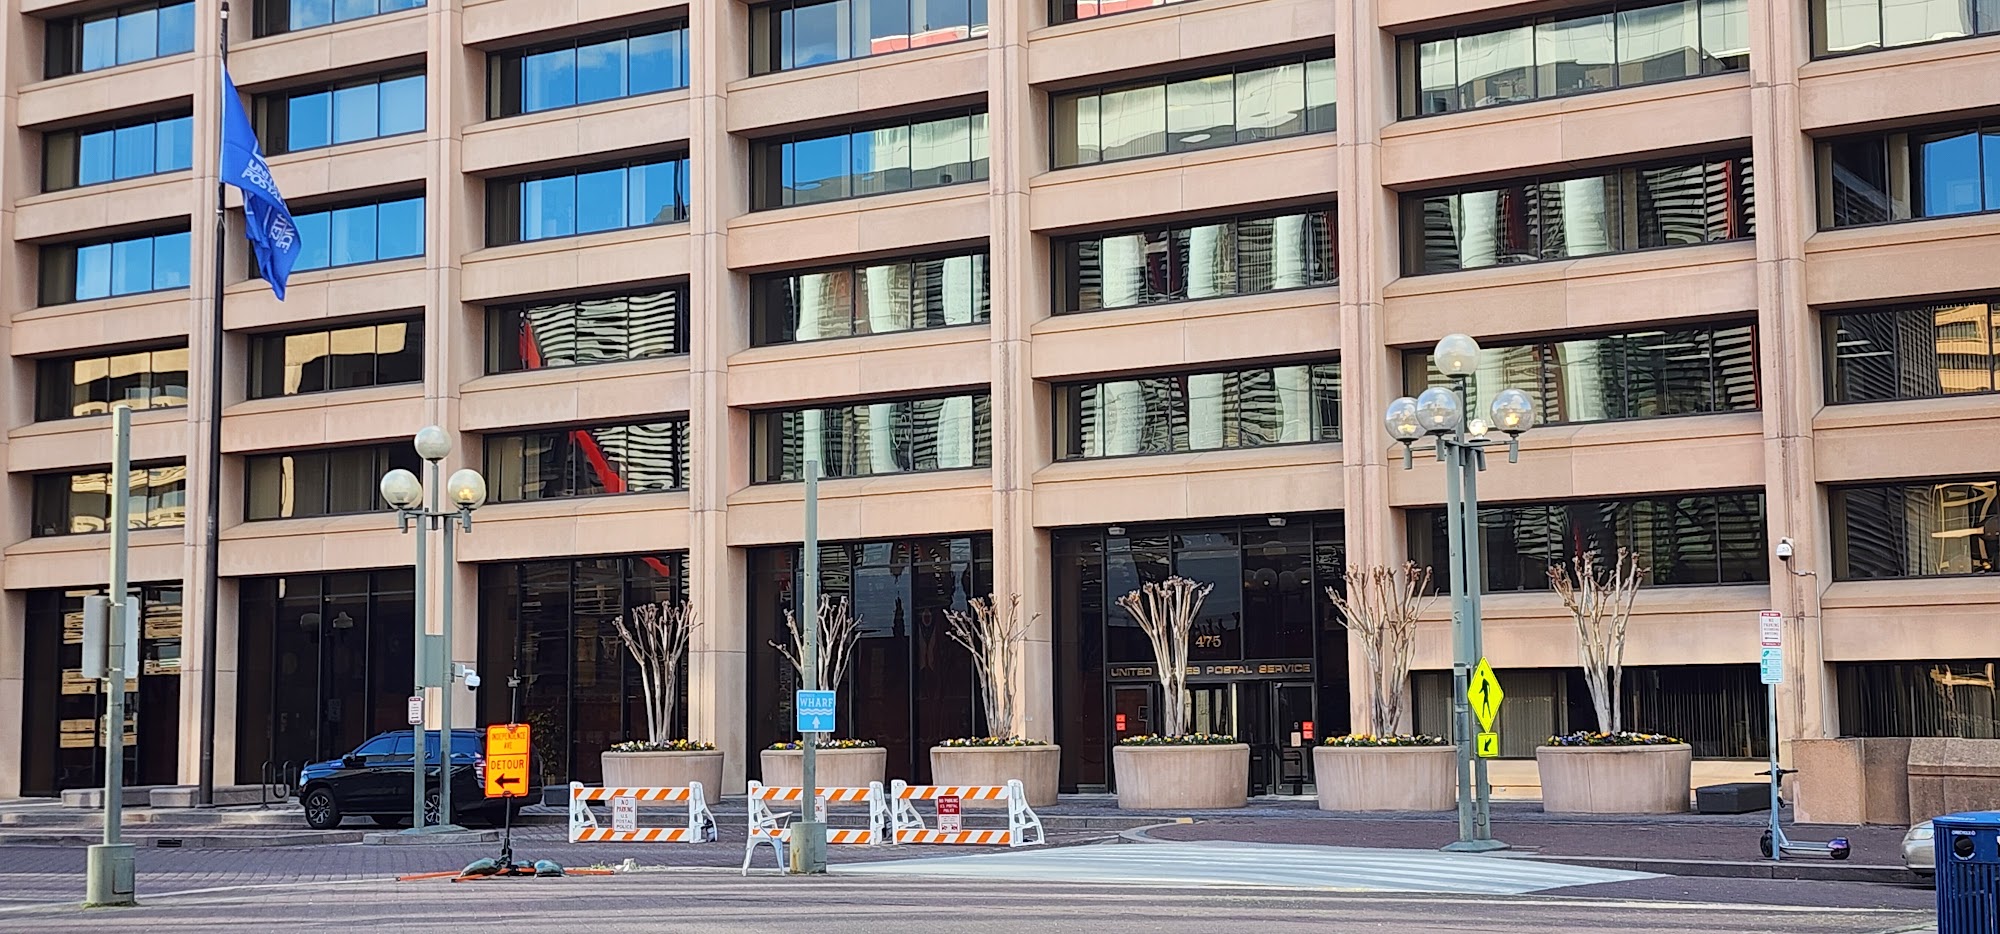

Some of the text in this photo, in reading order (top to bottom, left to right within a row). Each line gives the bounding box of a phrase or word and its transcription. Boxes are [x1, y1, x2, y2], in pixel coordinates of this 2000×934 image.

[1195, 635, 1222, 648] 475
[1110, 667, 1153, 677] UNITED
[1206, 665, 1252, 675] POSTAL
[1258, 663, 1311, 674] SERVICE
[800, 697, 834, 708] WHARF
[491, 760, 524, 770] DETOUR
